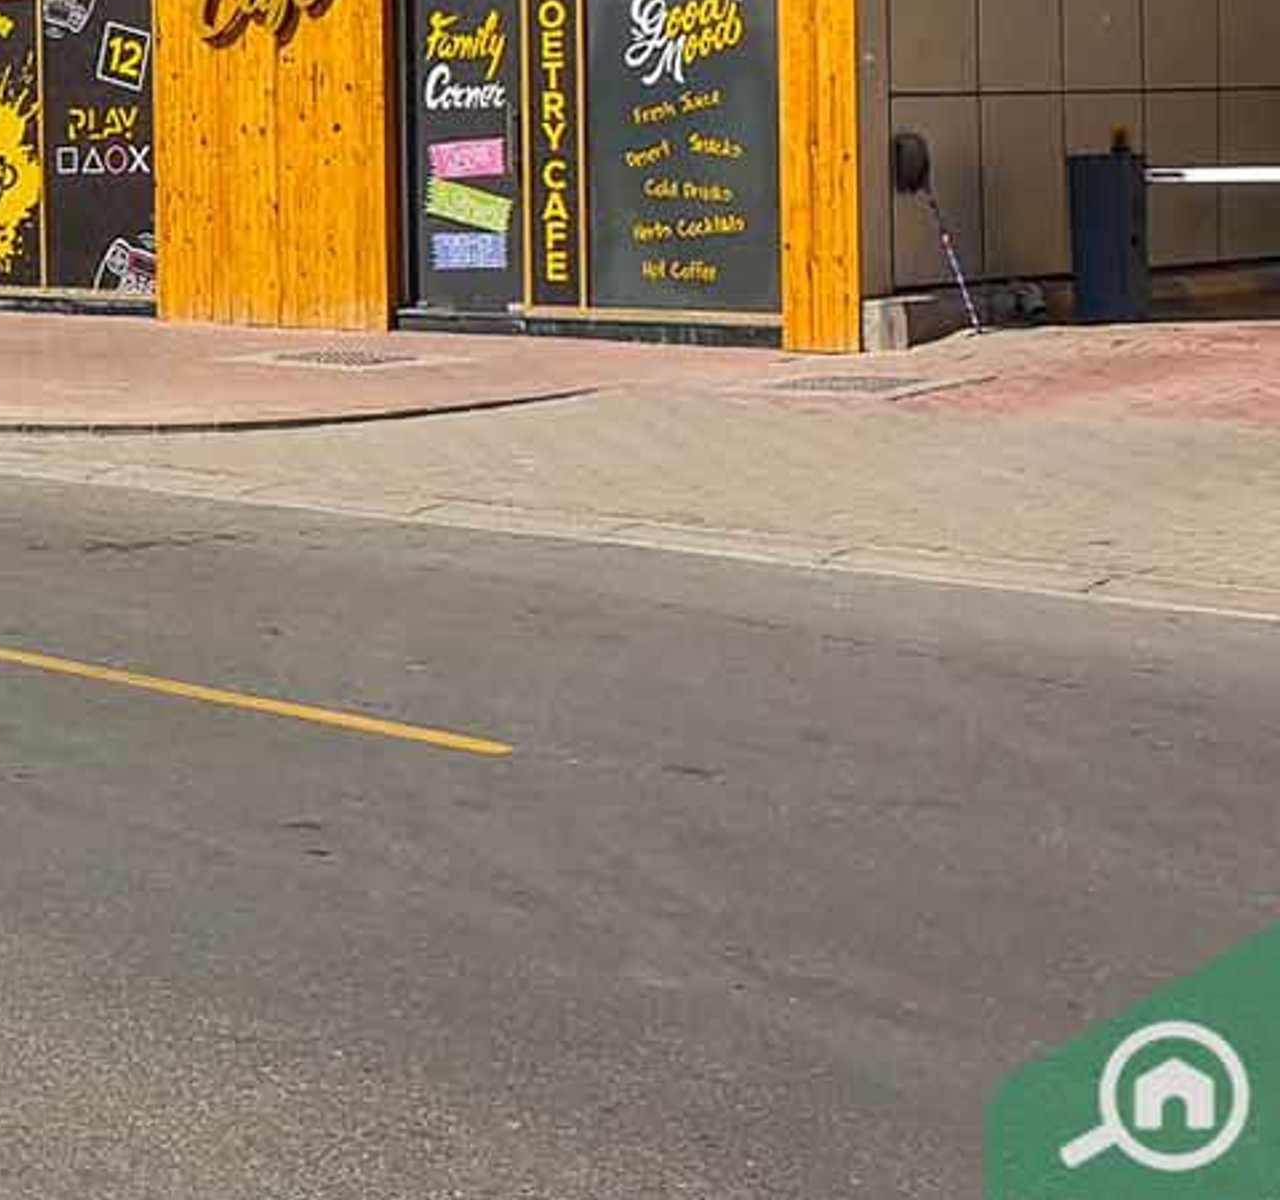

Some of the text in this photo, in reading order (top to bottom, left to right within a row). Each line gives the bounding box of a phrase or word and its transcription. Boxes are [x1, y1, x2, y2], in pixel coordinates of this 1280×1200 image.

[108, 36, 143, 77] 12
[425, 8, 507, 81] Family
[641, 2, 742, 85] Mood
[424, 63, 507, 111] Corner
[68, 105, 138, 141] PLAY
[542, 160, 569, 281] CAFE
